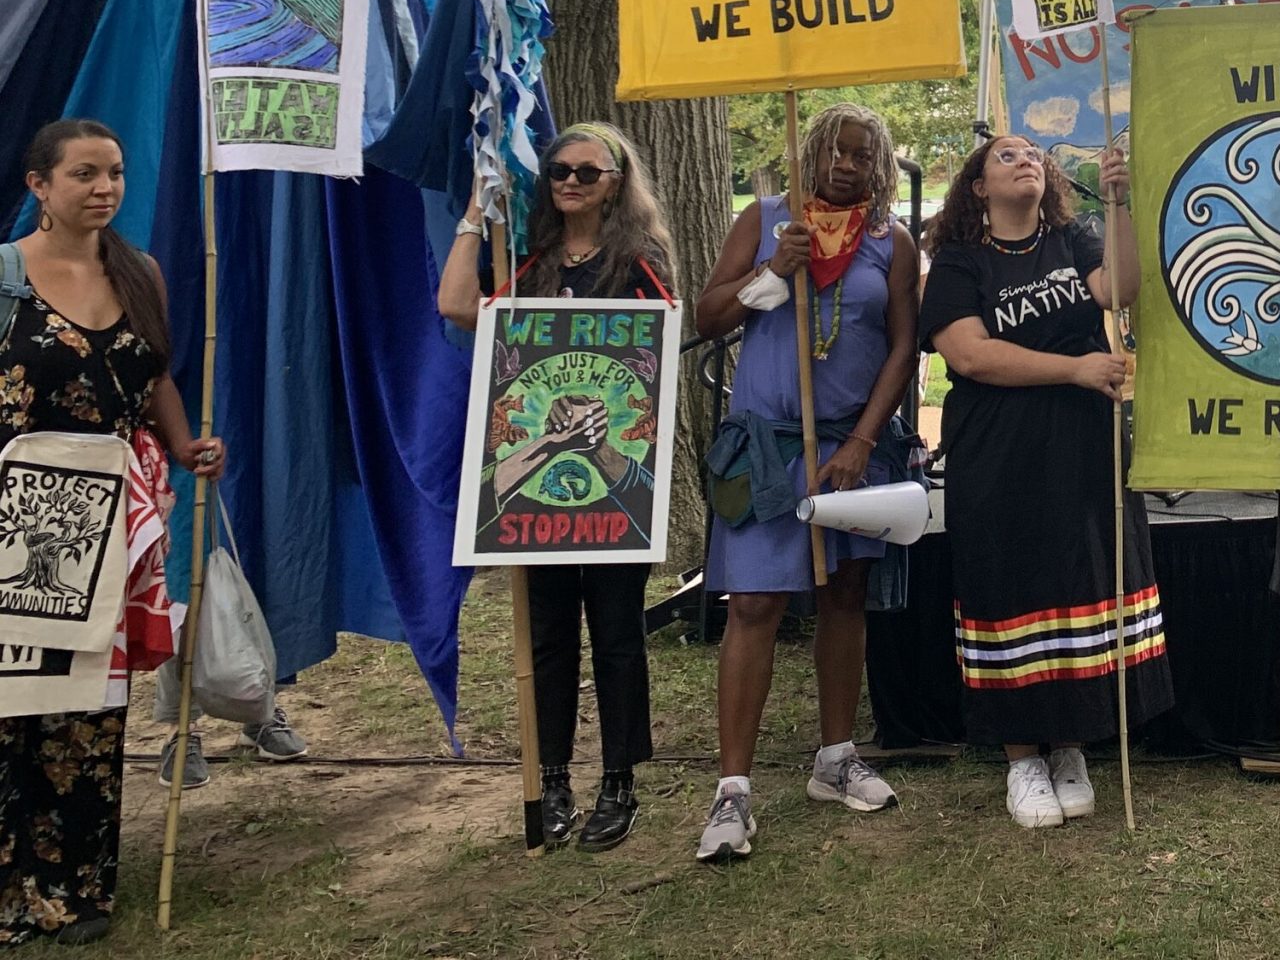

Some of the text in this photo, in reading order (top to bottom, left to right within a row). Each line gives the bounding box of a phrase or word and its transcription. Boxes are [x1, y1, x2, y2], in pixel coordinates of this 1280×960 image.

[691, 0, 750, 43] WE
[1041, 3, 1068, 27] IS
[994, 279, 1091, 333] NATIVE
[999, 277, 1049, 302] Simply
[502, 313, 656, 347] WE RISE
[519, 353, 635, 391] NOT JUST FOR
[541, 369, 610, 390] YOU & ME
[1188, 399, 1243, 435] WE
[4, 473, 114, 507] PROTECT
[499, 512, 628, 544] STOP MVP
